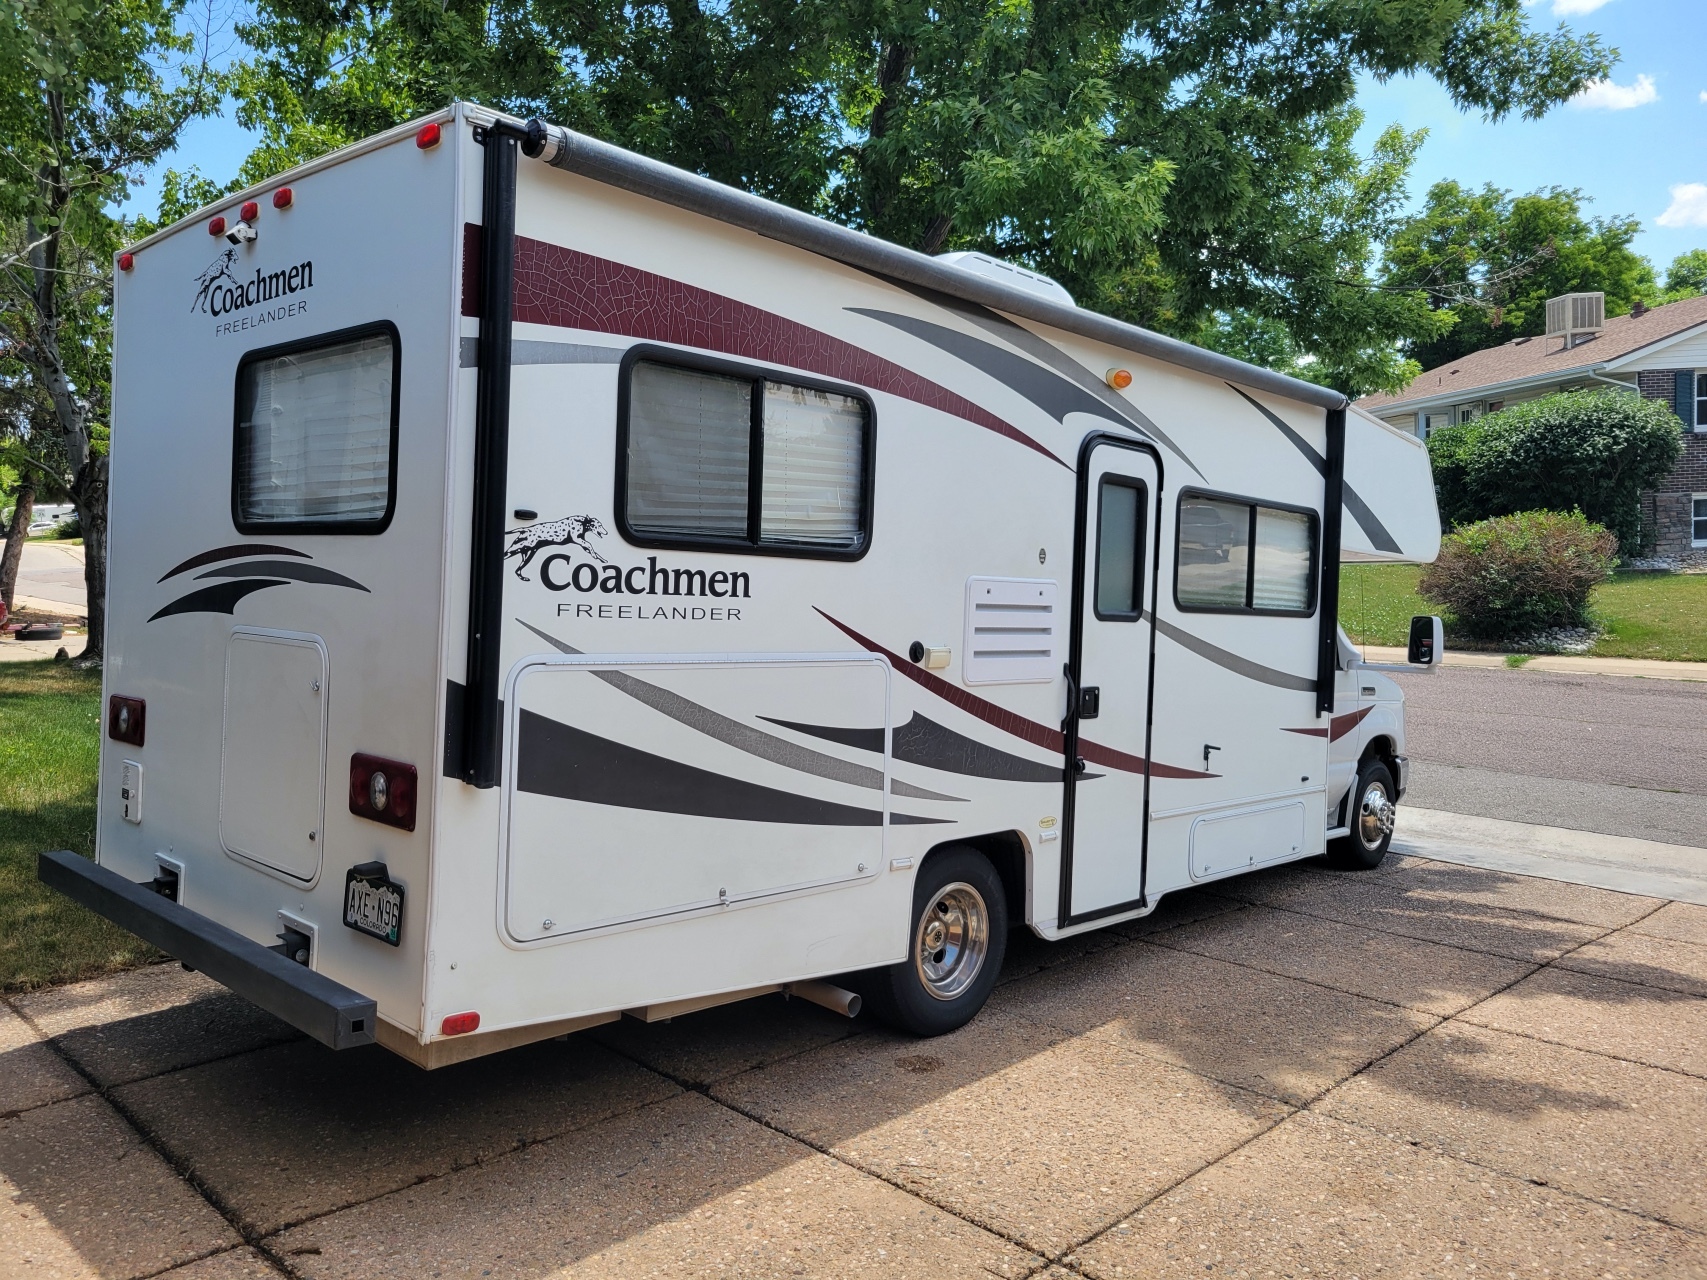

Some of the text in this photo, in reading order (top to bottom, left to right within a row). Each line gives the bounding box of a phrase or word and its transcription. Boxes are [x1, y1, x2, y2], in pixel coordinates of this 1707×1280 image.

[210, 261, 313, 317] Coachmen
[215, 300, 307, 337] FREELANDER
[540, 553, 751, 598] Coachmen
[557, 603, 741, 621] FREELANDER
[360, 917, 387, 934] COLORADO
